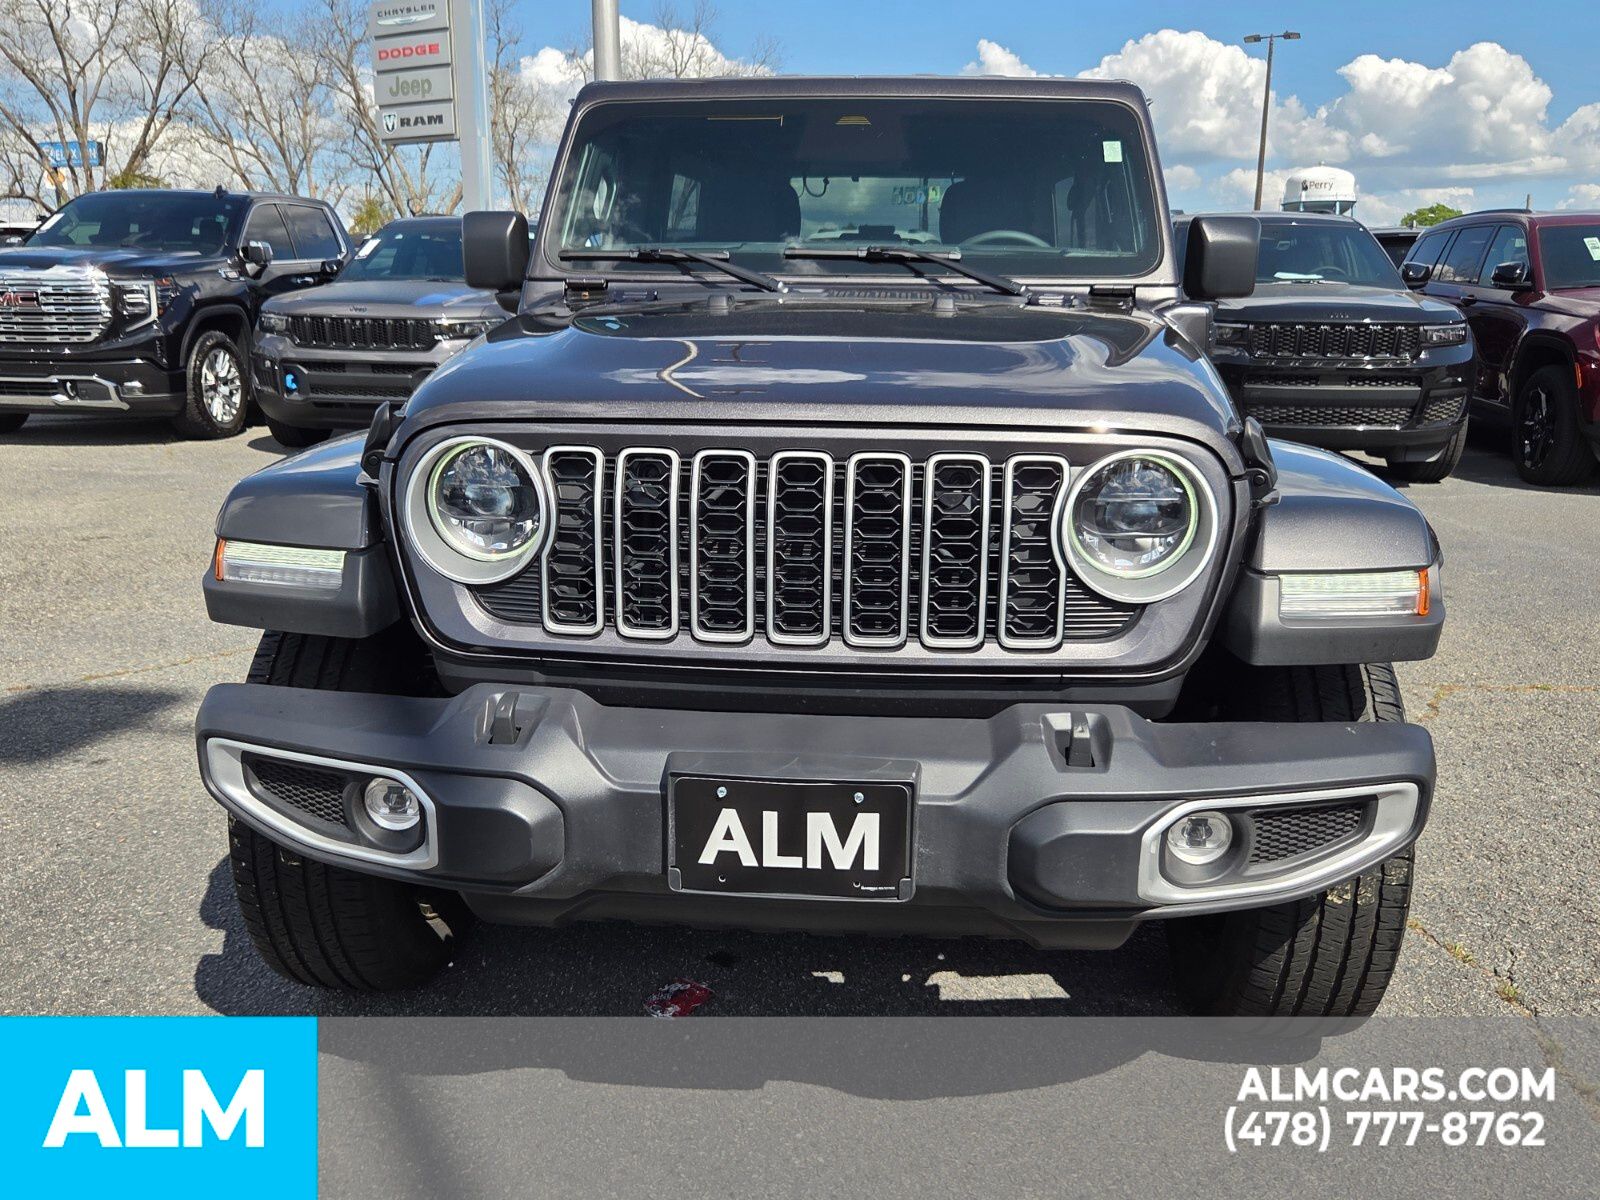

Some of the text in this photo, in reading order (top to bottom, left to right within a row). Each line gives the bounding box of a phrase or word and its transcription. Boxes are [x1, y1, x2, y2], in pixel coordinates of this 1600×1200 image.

[377, 4, 435, 17] CHRYSLER
[378, 43, 440, 60] DODGE
[389, 75, 432, 98] Jeep
[400, 114, 443, 128] RAM
[1309, 181, 1333, 191] Perry
[697, 807, 880, 871] ALM
